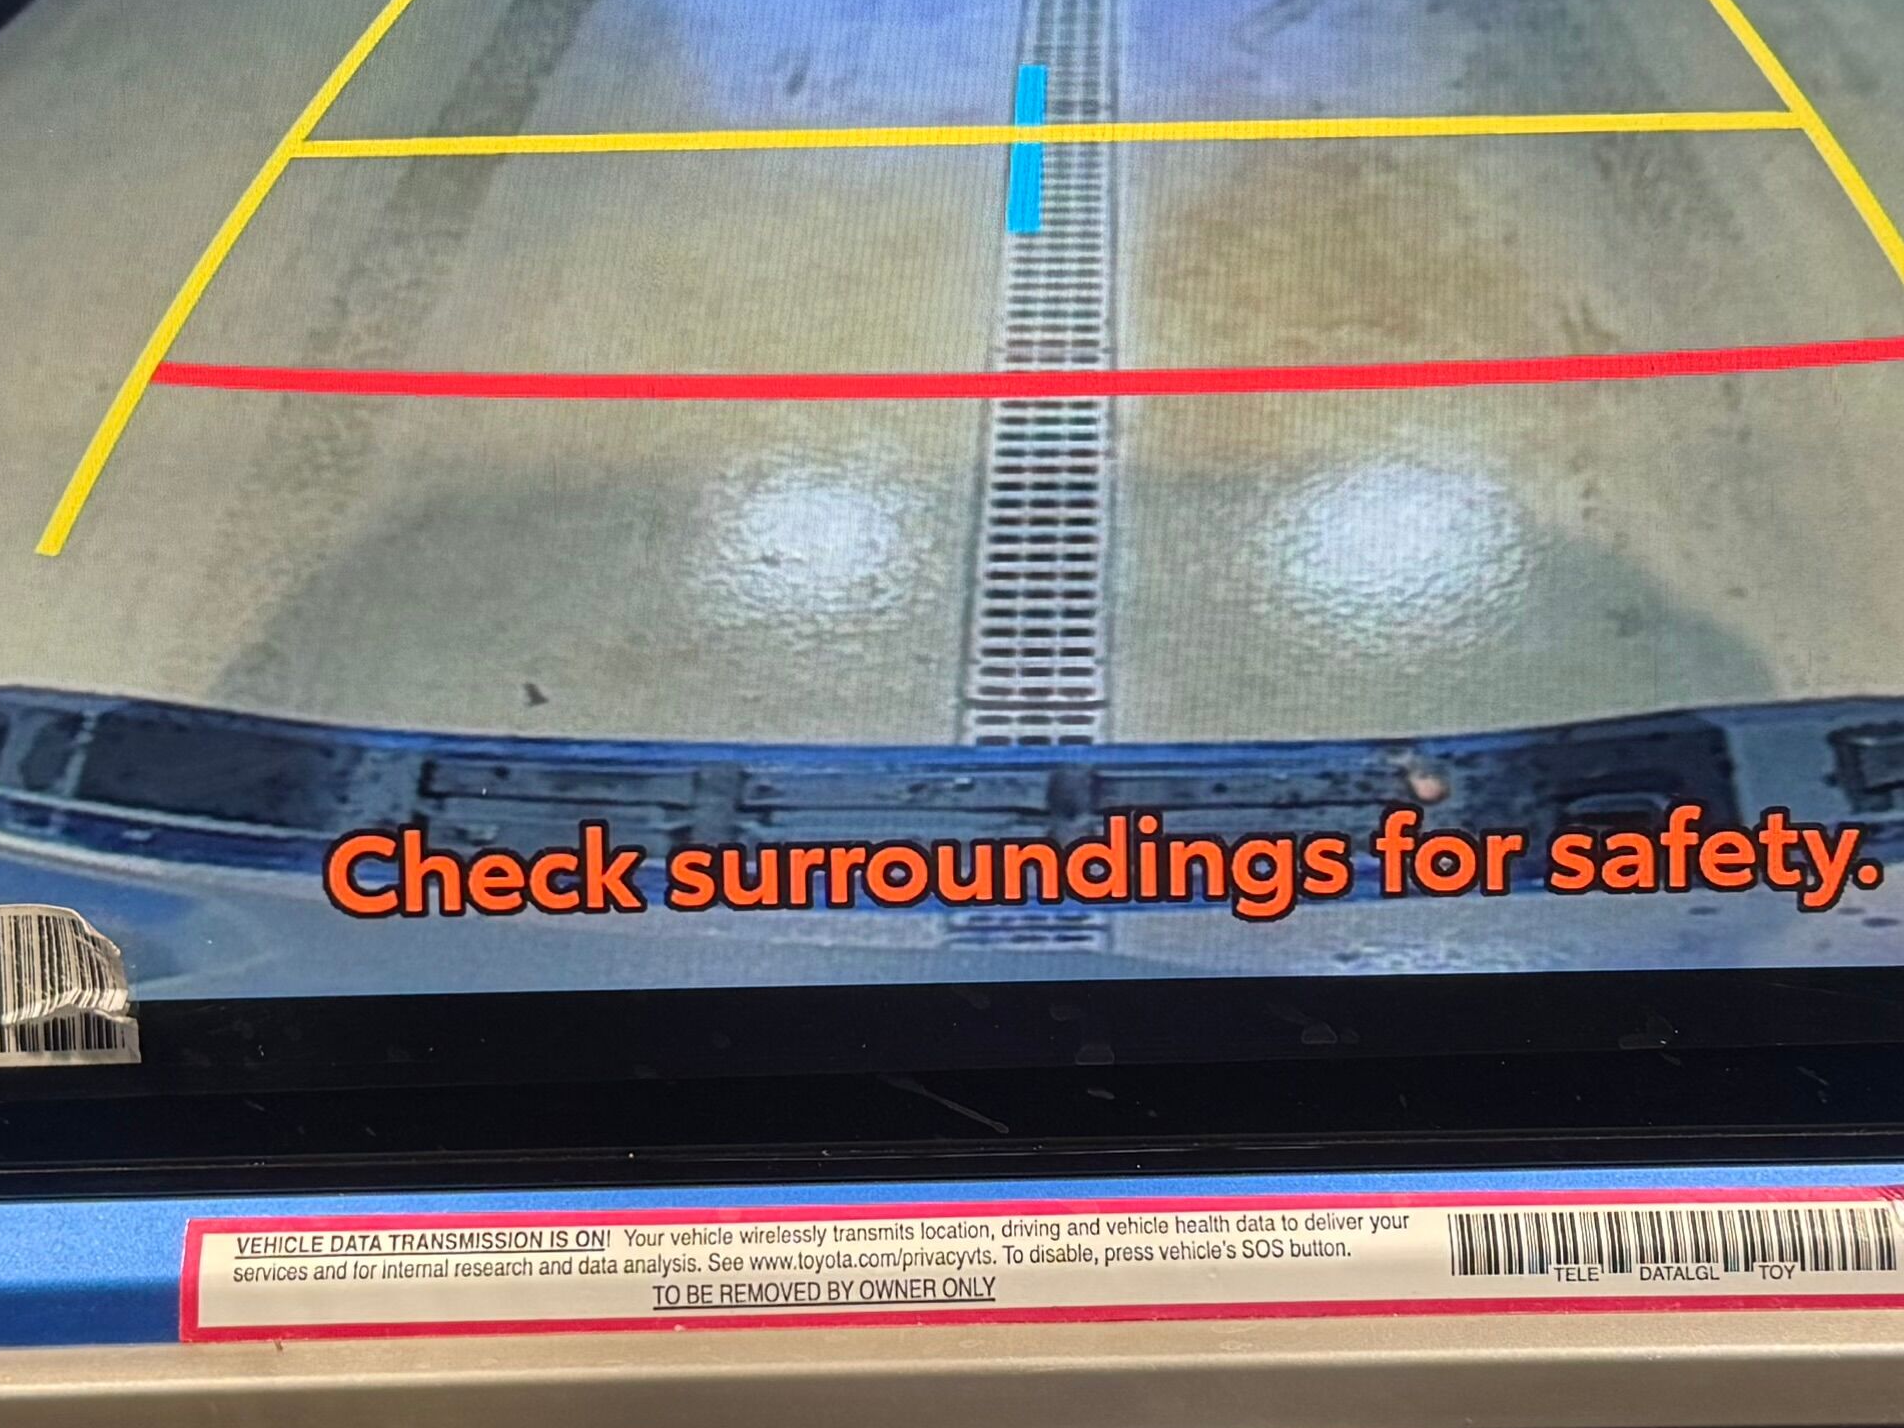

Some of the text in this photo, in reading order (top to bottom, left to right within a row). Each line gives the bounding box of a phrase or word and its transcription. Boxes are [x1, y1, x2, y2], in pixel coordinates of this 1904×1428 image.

[323, 804, 1882, 920] Check surroundings for safety.
[237, 1212, 1410, 1254] VEHICLE DATA TRANSMISSION IS ON! Your vehicle wirelessly transmits location, driving and vehicle health data to deliver your
[233, 1239, 1352, 1283] services and for internal research and data analysis. See www.toyota.com/privacyvts. To disable, press vehicle's SOS button.
[1554, 1263, 1797, 1283] TELE DATALGL TOY
[652, 1276, 995, 1305] TO BE REMOVED BY OWNER ONLY
